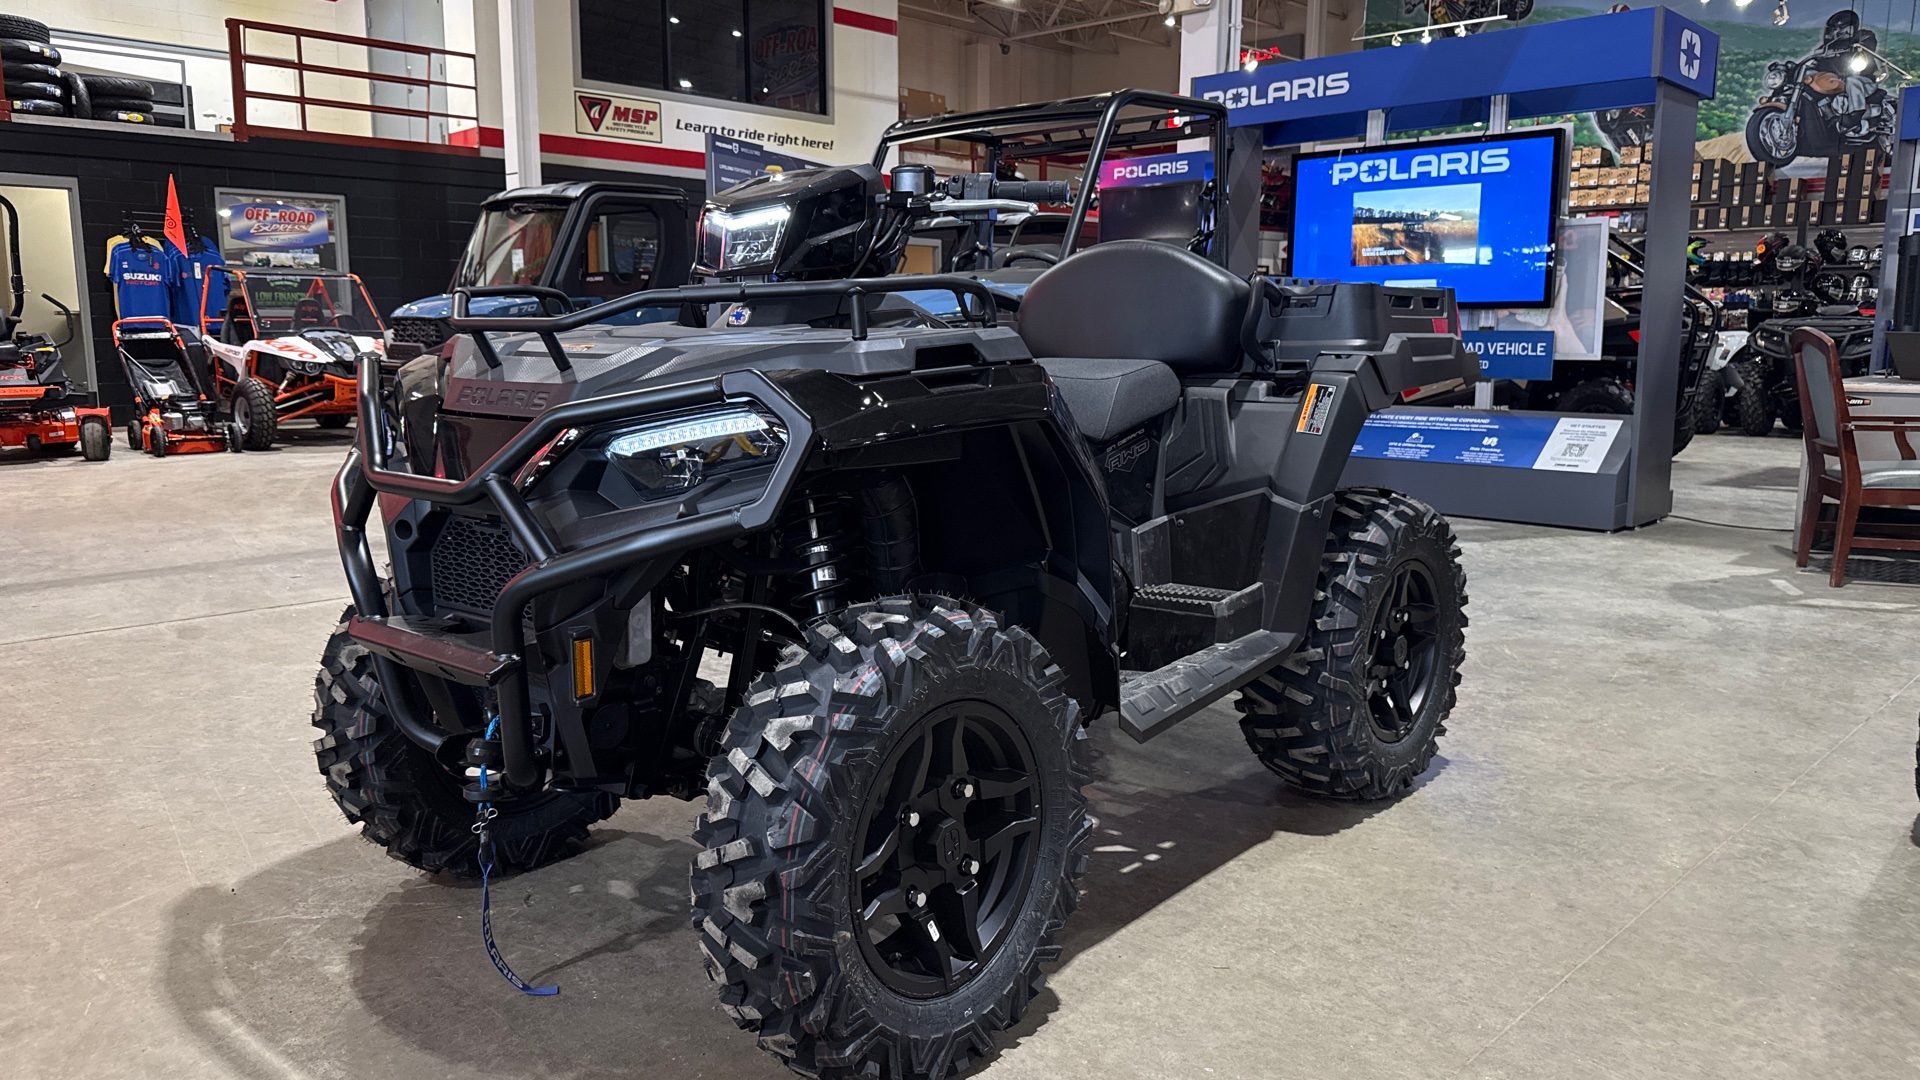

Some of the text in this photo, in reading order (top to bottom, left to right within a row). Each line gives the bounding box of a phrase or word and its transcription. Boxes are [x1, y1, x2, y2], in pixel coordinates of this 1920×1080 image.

[612, 106, 658, 125] MSP
[612, 122, 647, 130] MOTORCYCLE
[676, 118, 835, 150] Learn to ride right here!
[1113, 160, 1189, 180] POLARIS
[1332, 148, 1510, 186] POLARIS
[123, 272, 162, 282] SUZUKI
[255, 291, 273, 302] LOW
[1488, 342, 1547, 356] VEHICLE
[457, 385, 550, 411] POLARIS
[1117, 428, 1145, 446] DEMAND
[1108, 438, 1150, 473] AWD
[483, 908, 523, 989] POLARIS
